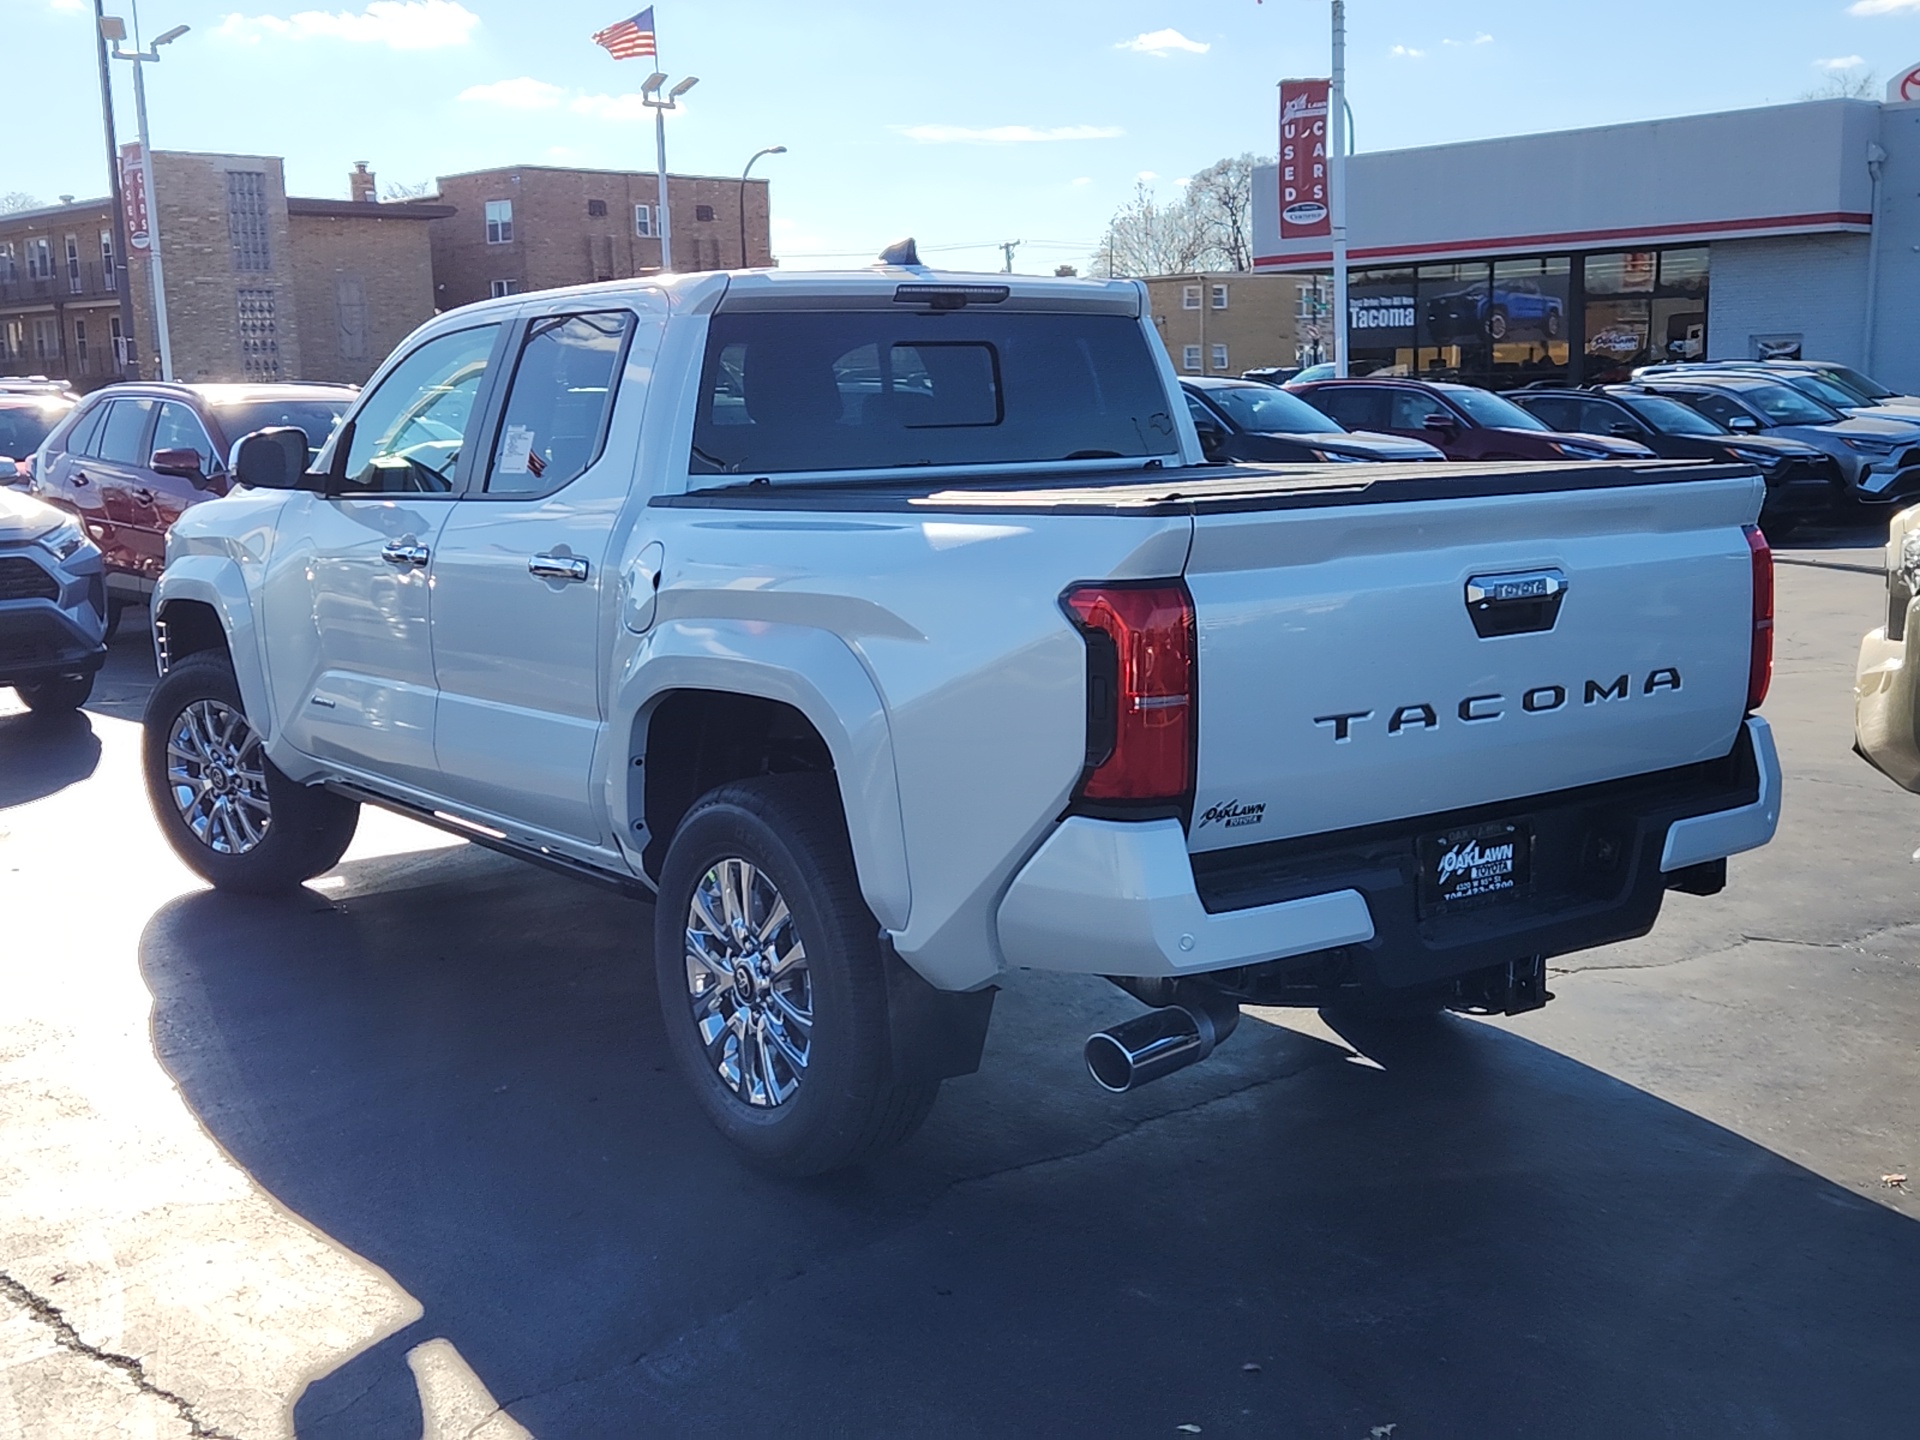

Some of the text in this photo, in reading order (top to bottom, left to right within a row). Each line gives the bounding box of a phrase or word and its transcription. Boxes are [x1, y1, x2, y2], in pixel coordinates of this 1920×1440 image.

[1284, 125, 1296, 201] USED
[1313, 121, 1324, 199] CARS
[125, 174, 136, 231] USED
[136, 172, 147, 230] CARS
[1349, 307, 1415, 328] Tacoma
[1313, 667, 1682, 743] TACOMA
[1439, 842, 1514, 876] OAKLAWN
[1475, 860, 1508, 878] TOYOTA
